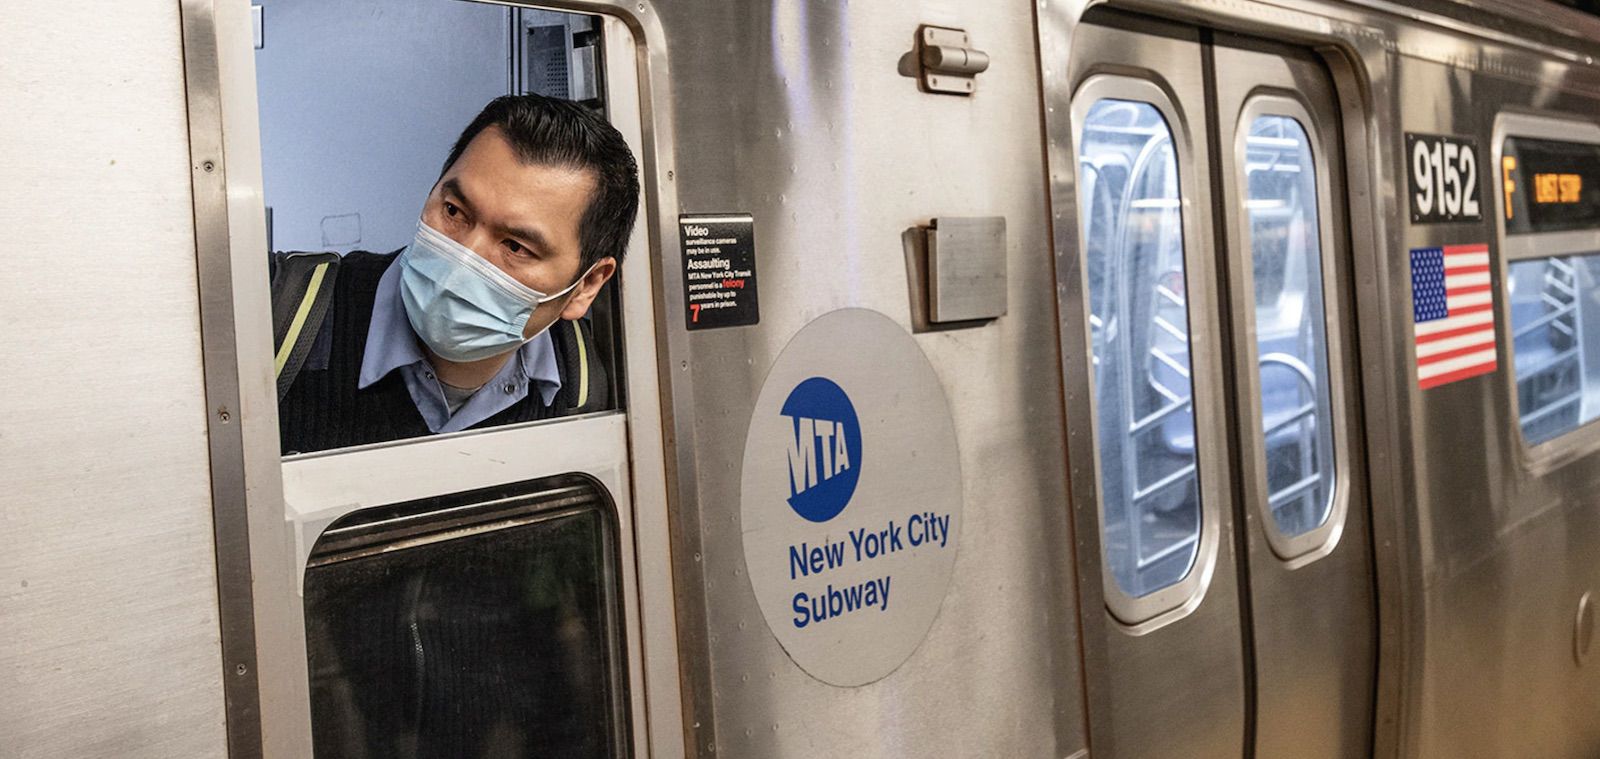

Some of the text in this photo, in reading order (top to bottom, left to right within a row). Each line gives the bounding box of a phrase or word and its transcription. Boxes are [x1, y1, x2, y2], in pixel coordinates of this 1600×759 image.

[1413, 140, 1480, 217] 9152
[1503, 155, 1516, 220] F
[684, 225, 709, 236] Video
[687, 258, 730, 270] Assaulting
[688, 282, 714, 291] personnel
[722, 279, 744, 289] felony
[690, 293, 716, 301] punishable
[690, 304, 700, 322] 7
[782, 415, 850, 498] MTA
[789, 512, 950, 580] New York City
[792, 575, 891, 628] Subway
